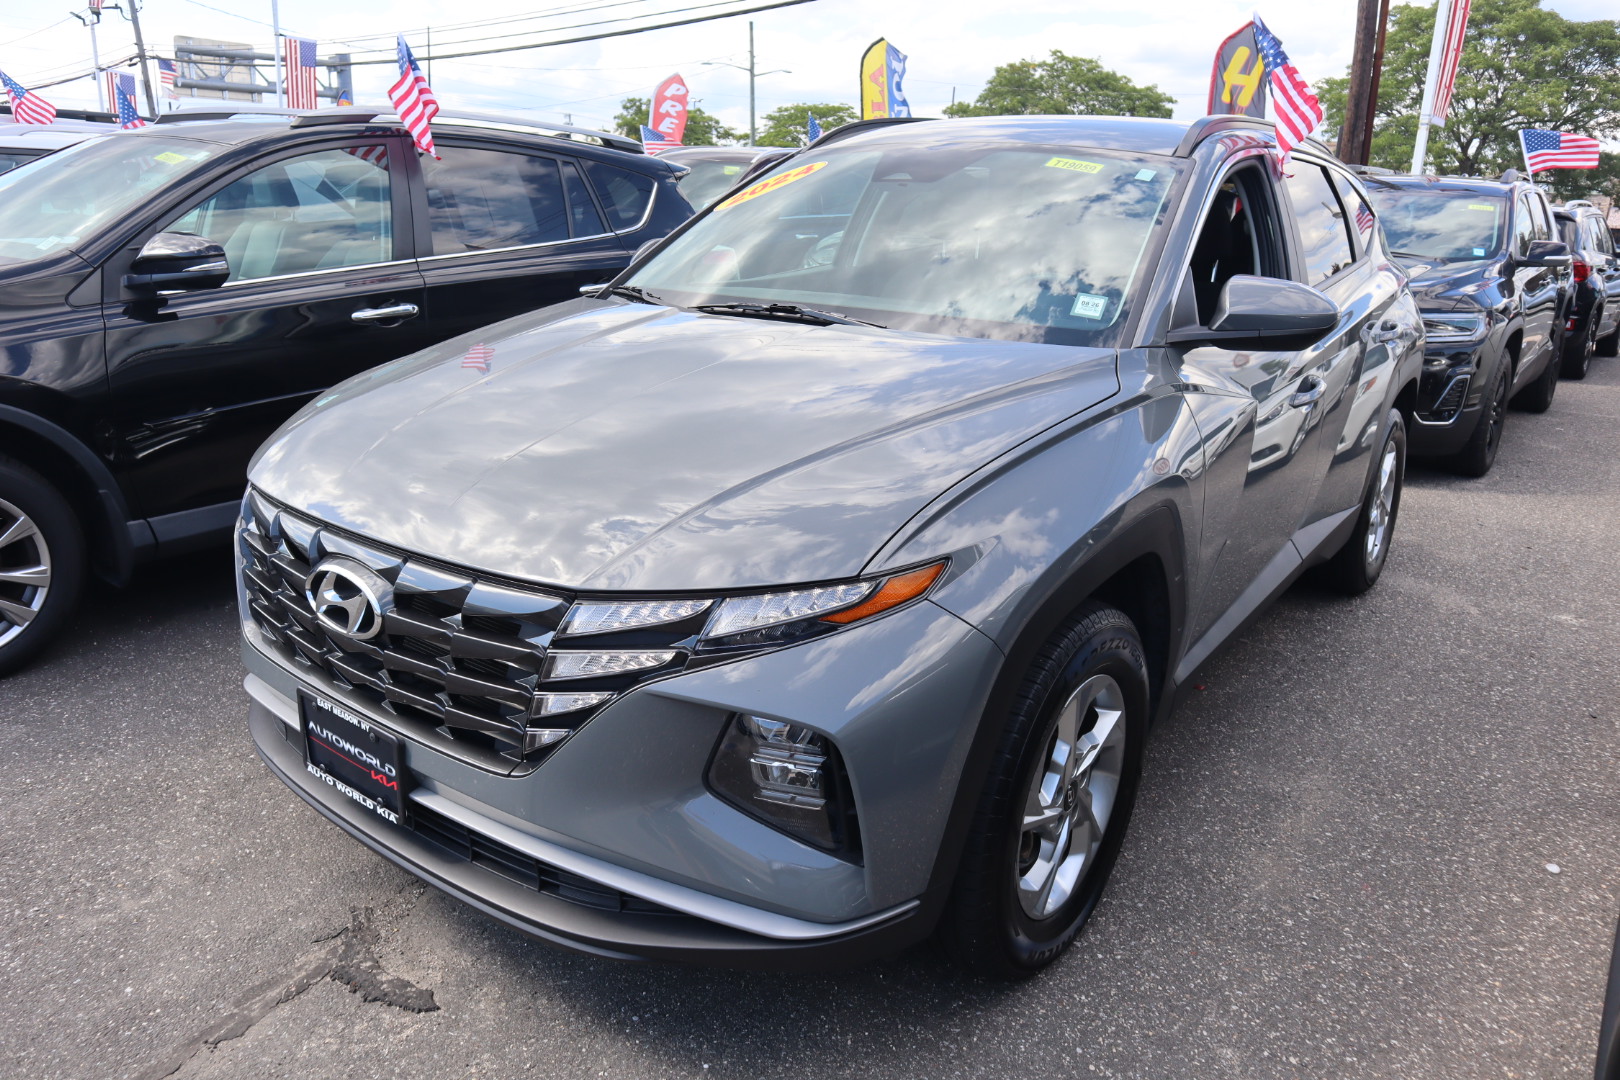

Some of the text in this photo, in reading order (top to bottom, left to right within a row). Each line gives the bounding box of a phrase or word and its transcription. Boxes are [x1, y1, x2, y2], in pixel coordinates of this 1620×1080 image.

[725, 164, 816, 207] 2024
[316, 697, 332, 712] EAST
[360, 719, 370, 732] NY
[308, 720, 396, 777] AUTOWORLD
[306, 763, 398, 825] AUTO WORLD KIA
